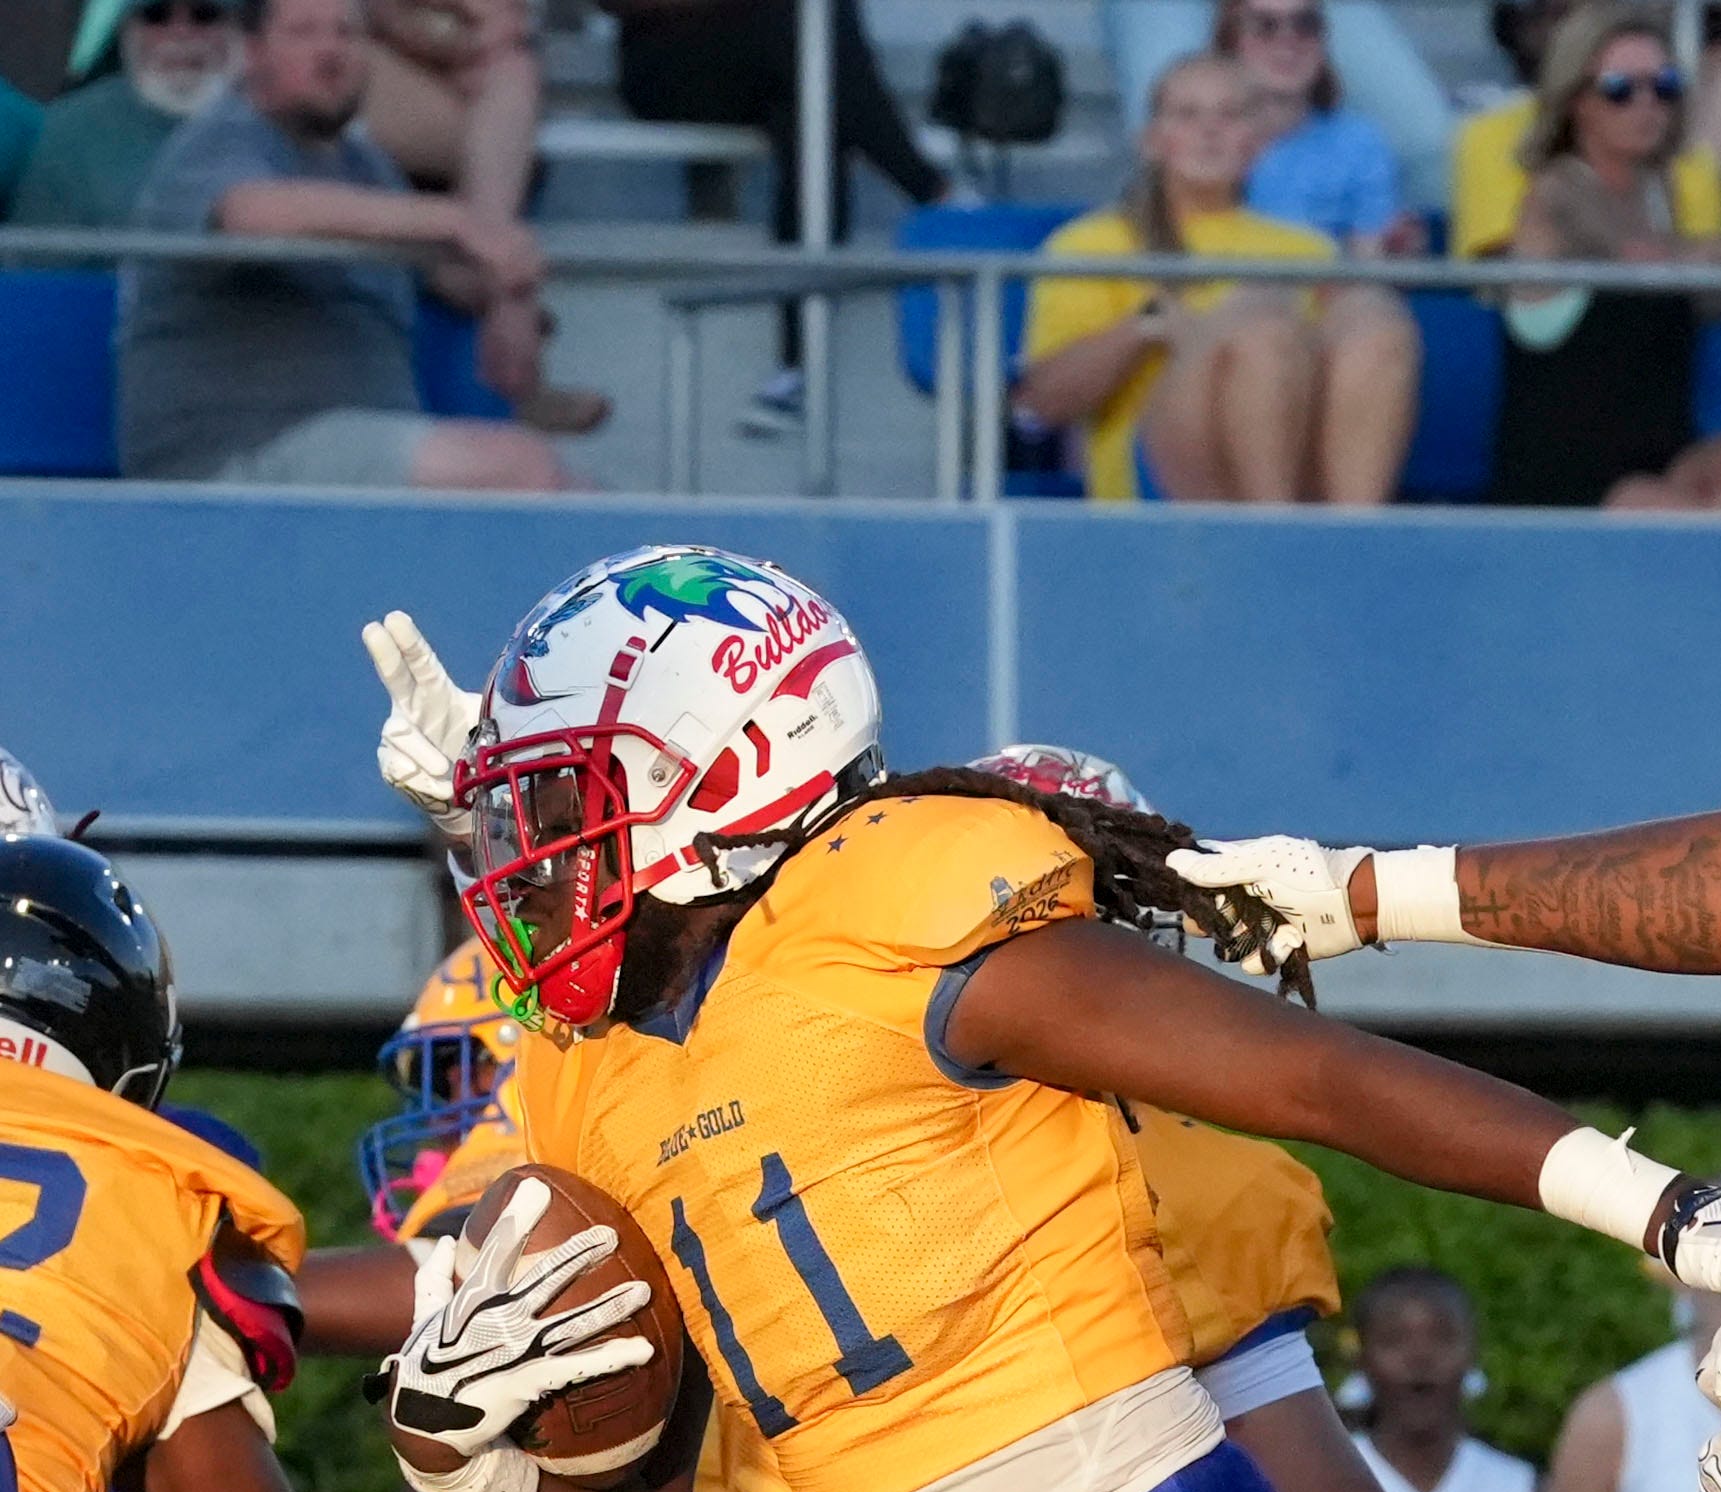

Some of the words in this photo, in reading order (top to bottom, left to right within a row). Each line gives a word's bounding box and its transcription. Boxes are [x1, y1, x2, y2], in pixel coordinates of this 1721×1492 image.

[711, 595, 834, 694] Bulldo
[1006, 893, 1060, 935] 2026
[696, 1100, 745, 1139] GOLD
[669, 1152, 914, 1438] 11
